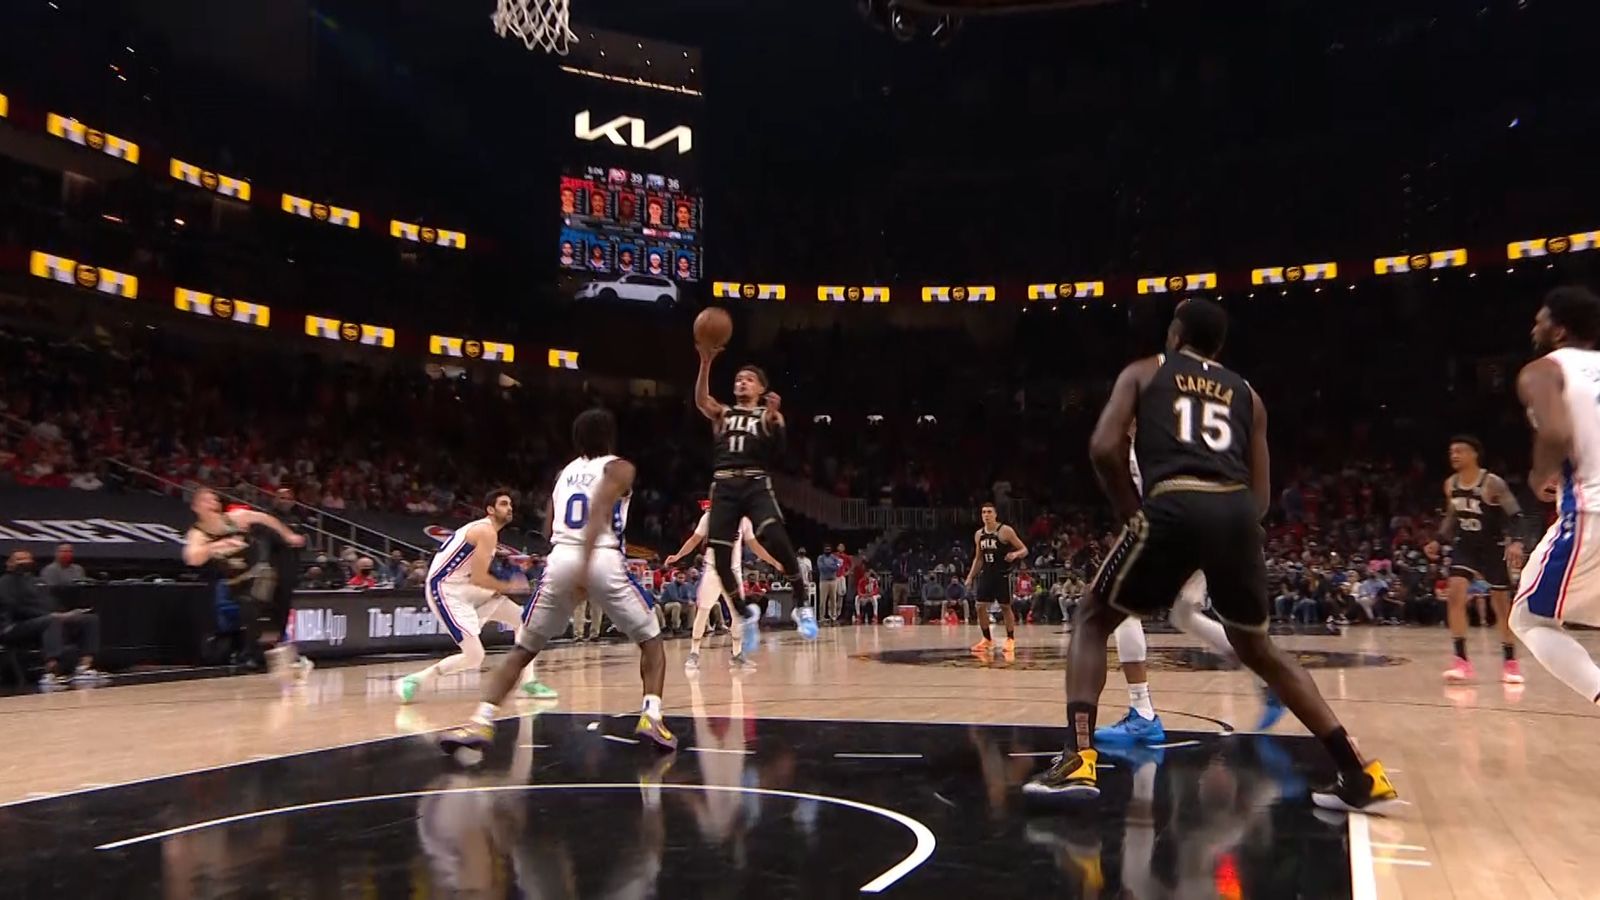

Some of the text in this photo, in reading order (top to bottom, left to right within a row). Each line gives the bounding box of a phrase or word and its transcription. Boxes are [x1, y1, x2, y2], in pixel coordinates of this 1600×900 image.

[1175, 373, 1234, 407] CAPELA
[1174, 396, 1232, 452] 15
[728, 435, 745, 453] 11
[564, 493, 589, 529] 0
[368, 608, 393, 637] The
